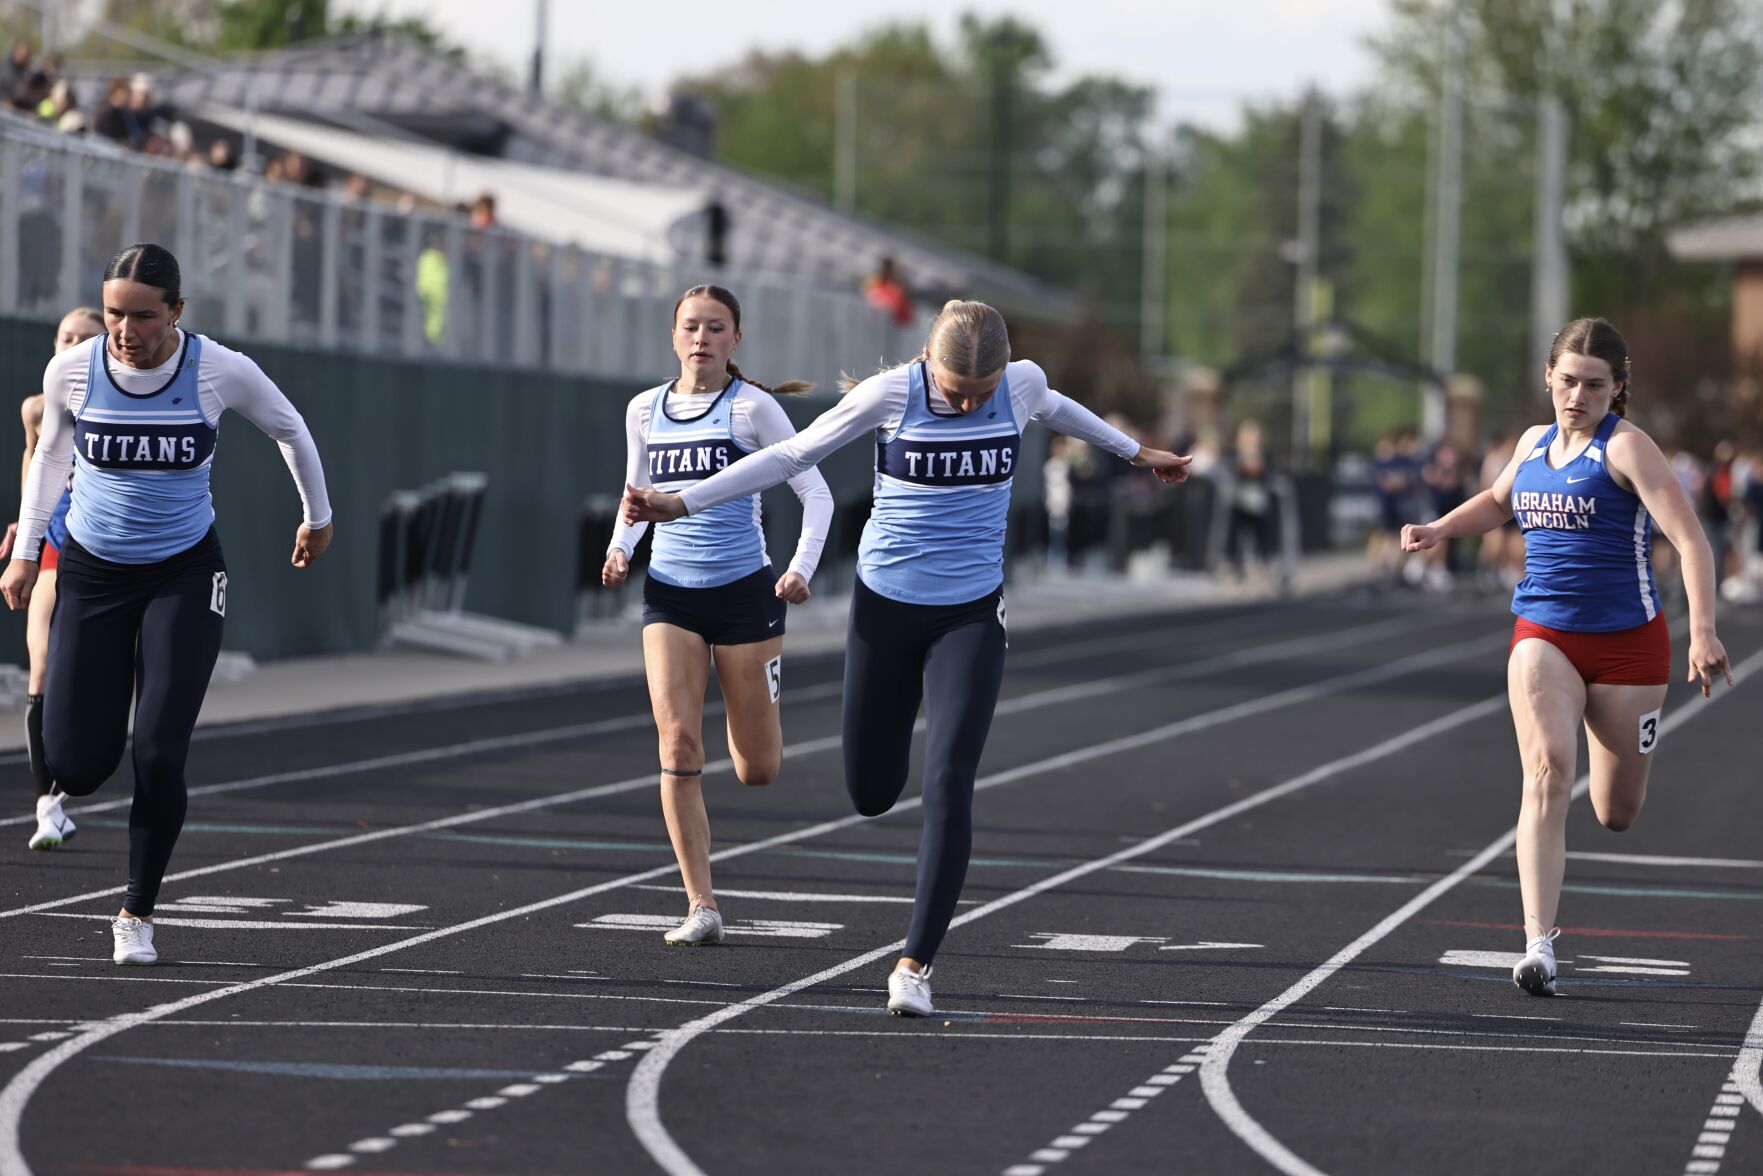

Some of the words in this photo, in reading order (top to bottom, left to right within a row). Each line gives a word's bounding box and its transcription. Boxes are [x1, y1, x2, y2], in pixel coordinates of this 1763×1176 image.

[85, 432, 195, 463] TITANS
[648, 446, 728, 476] TITANS
[905, 447, 1012, 477] TITANS
[1513, 491, 1596, 514] ABRAHAM
[1518, 511, 1589, 530] LINCOLN
[770, 659, 779, 699] 5
[1642, 718, 1656, 748] 3
